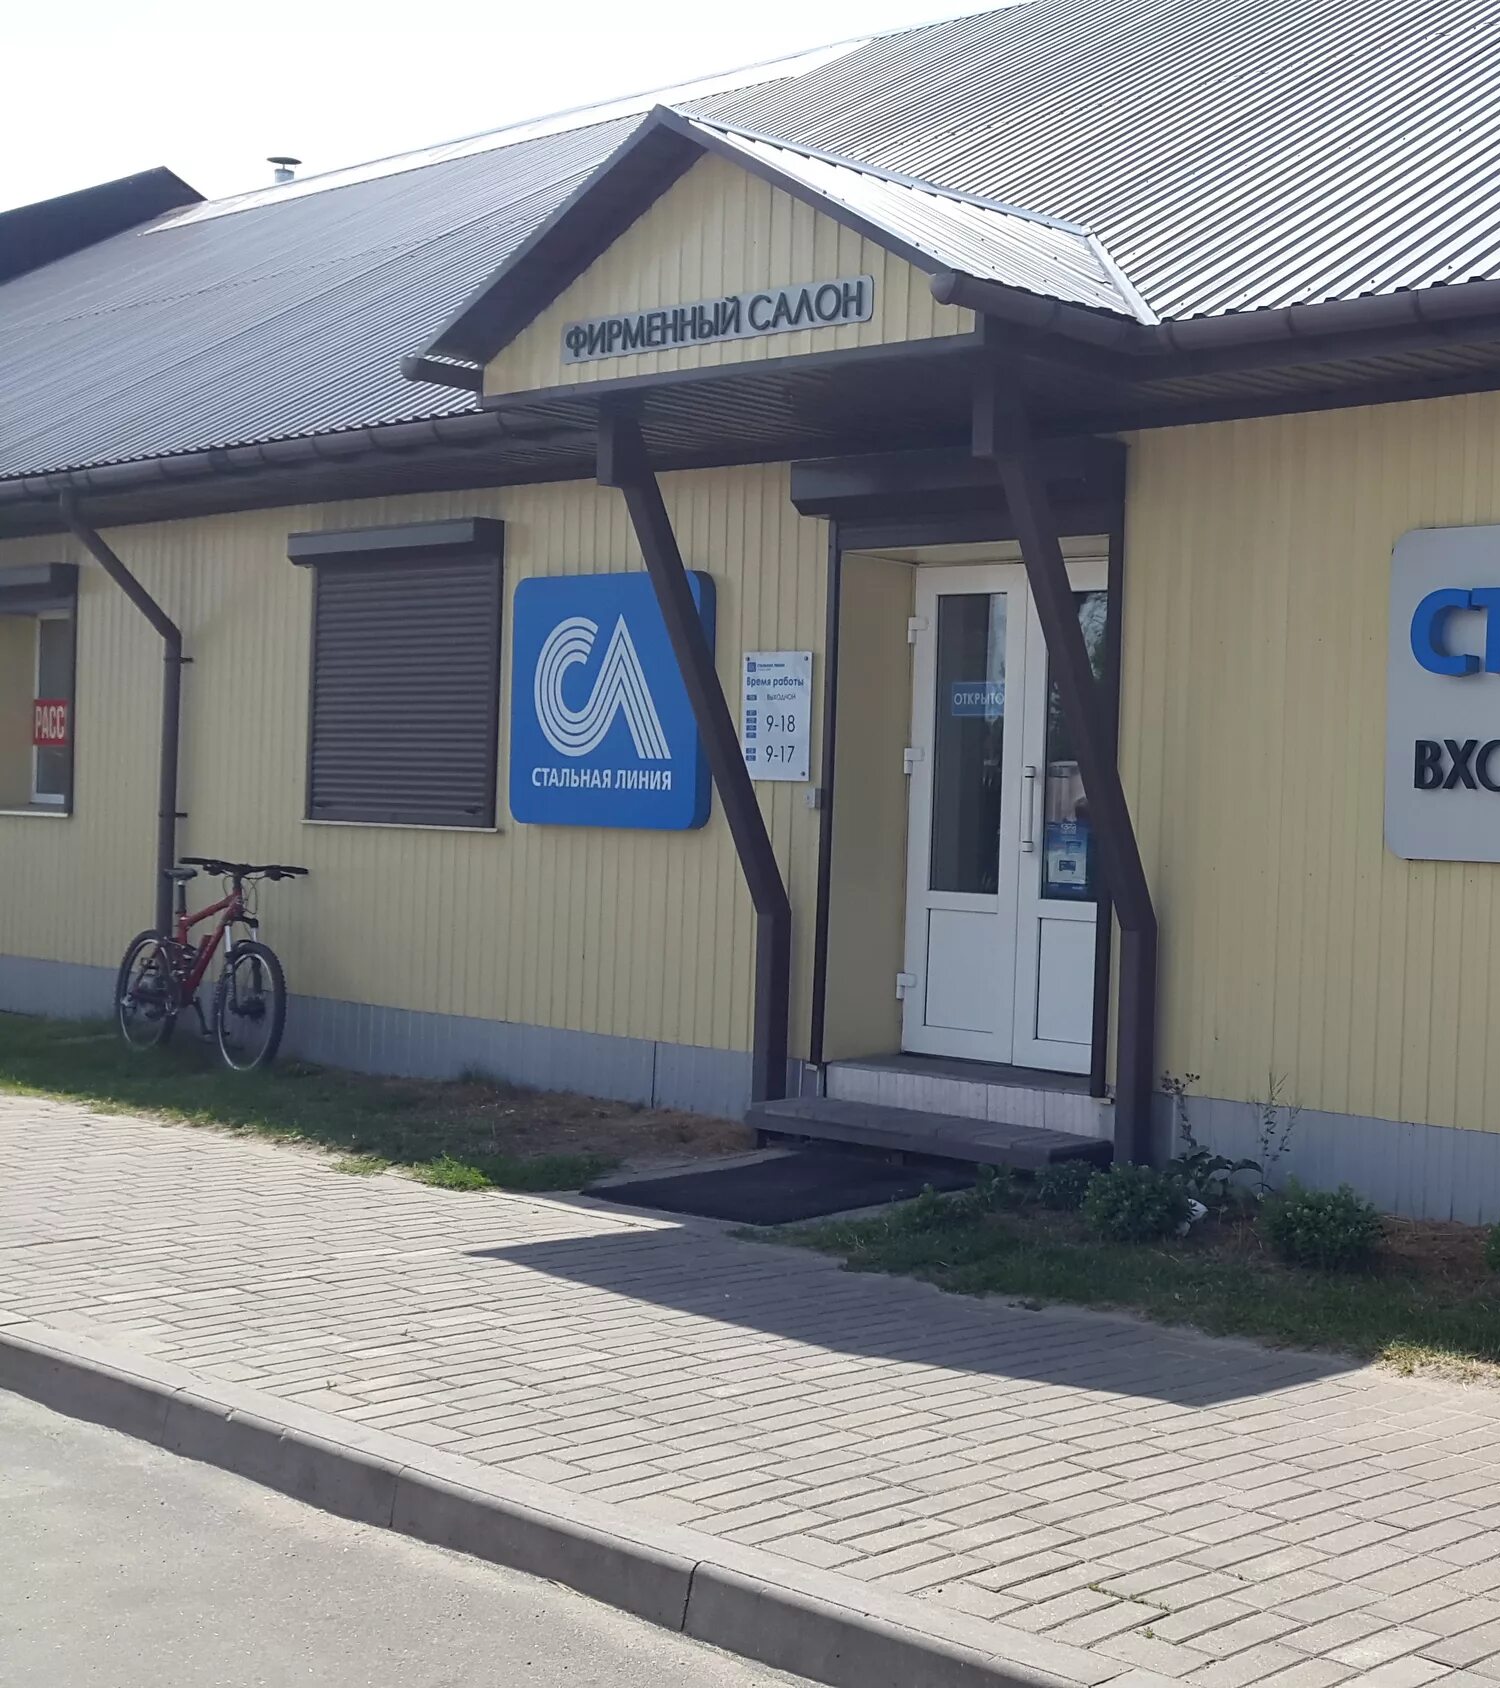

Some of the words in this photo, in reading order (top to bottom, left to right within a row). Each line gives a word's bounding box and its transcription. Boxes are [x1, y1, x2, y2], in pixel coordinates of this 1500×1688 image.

[565, 296, 741, 357] ФИРМЕННЫЙ
[748, 280, 863, 331] САЛОН
[953, 692, 1004, 705] ОТКРЫТО
[35, 706, 67, 739] РАСС
[766, 714, 796, 732] 9-18
[765, 745, 795, 763] 9-17
[532, 767, 611, 789] СТАЛЬНАЯ
[615, 769, 672, 791] ЛИНИЯ
